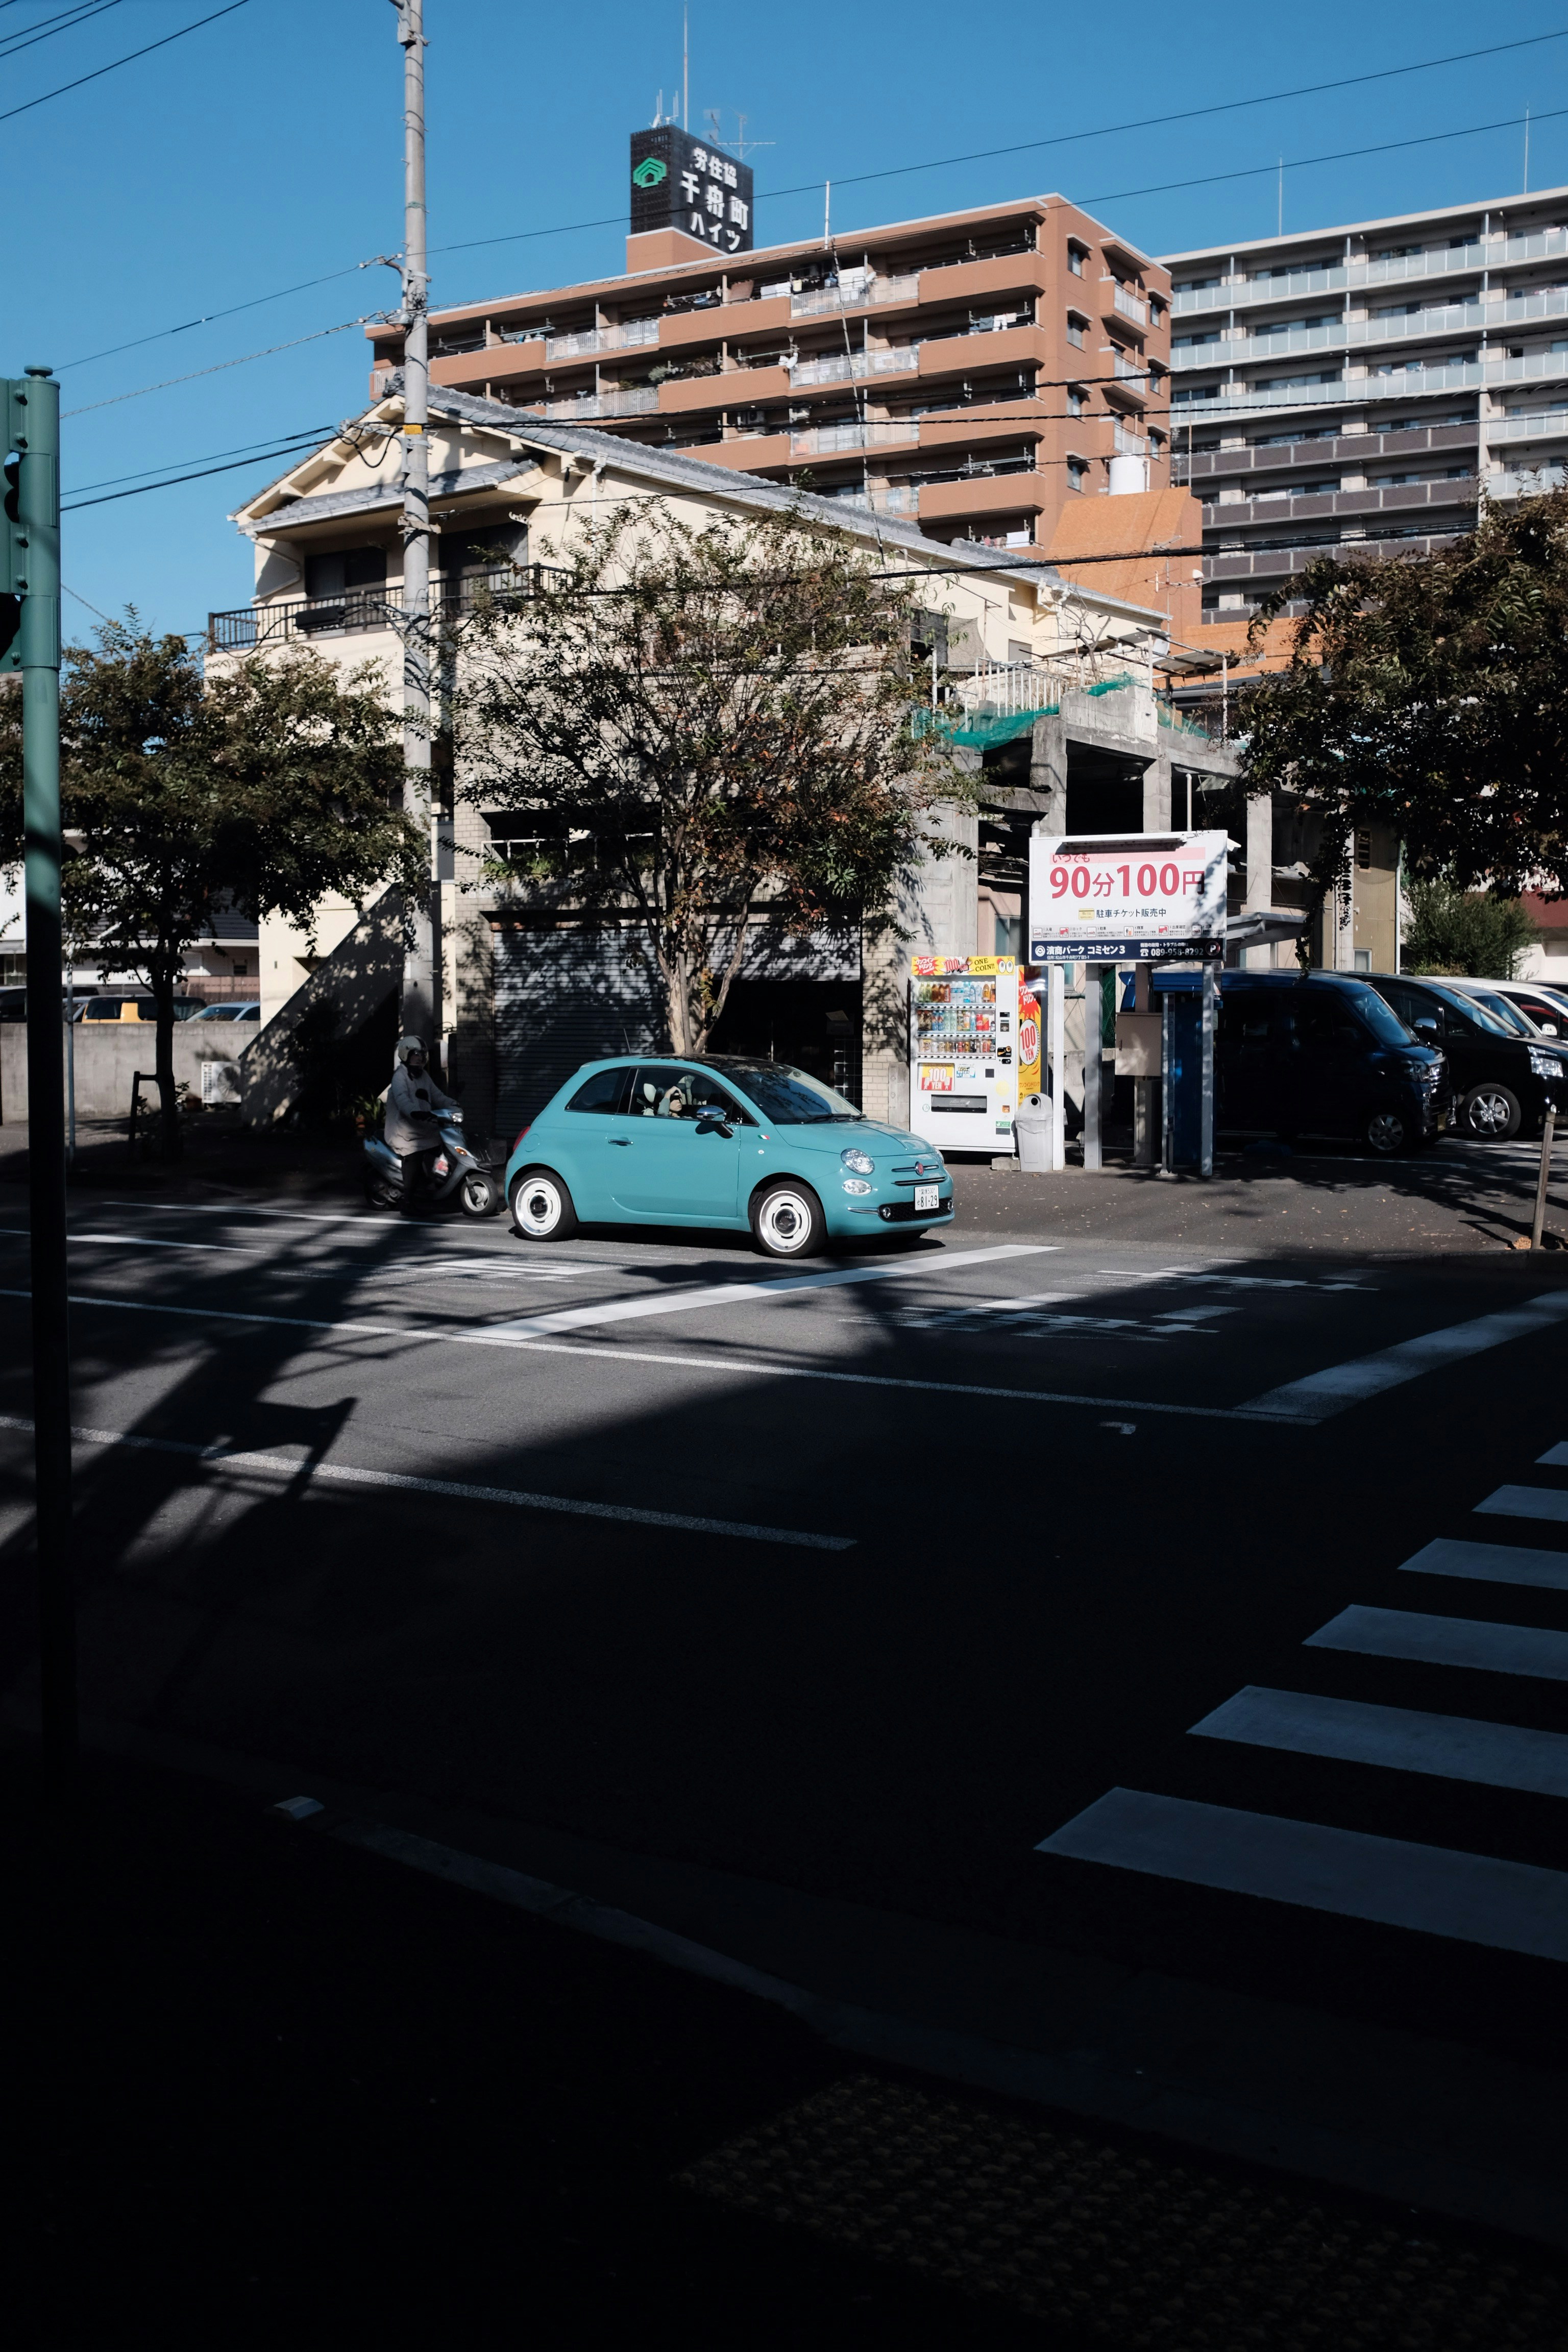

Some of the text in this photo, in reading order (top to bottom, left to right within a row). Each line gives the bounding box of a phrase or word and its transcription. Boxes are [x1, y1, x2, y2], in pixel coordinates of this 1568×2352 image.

[680, 170, 748, 230] 千舟町
[690, 212, 740, 251] ハイツ
[1052, 853, 1090, 863] いつでも
[1050, 863, 1205, 899] 90分100円
[1096, 908, 1166, 918] 駐車チケット販売中
[1088, 945, 1125, 954] コミセン3
[1151, 948, 1204, 957] 089-958-8292
[945, 958, 959, 972] 100
[975, 964, 995, 972] COIN!!
[1020, 1024, 1036, 1050] 100
[1025, 1048, 1034, 1061] YEN
[928, 1068, 947, 1082] 100
[932, 1082, 942, 1090] YEN
